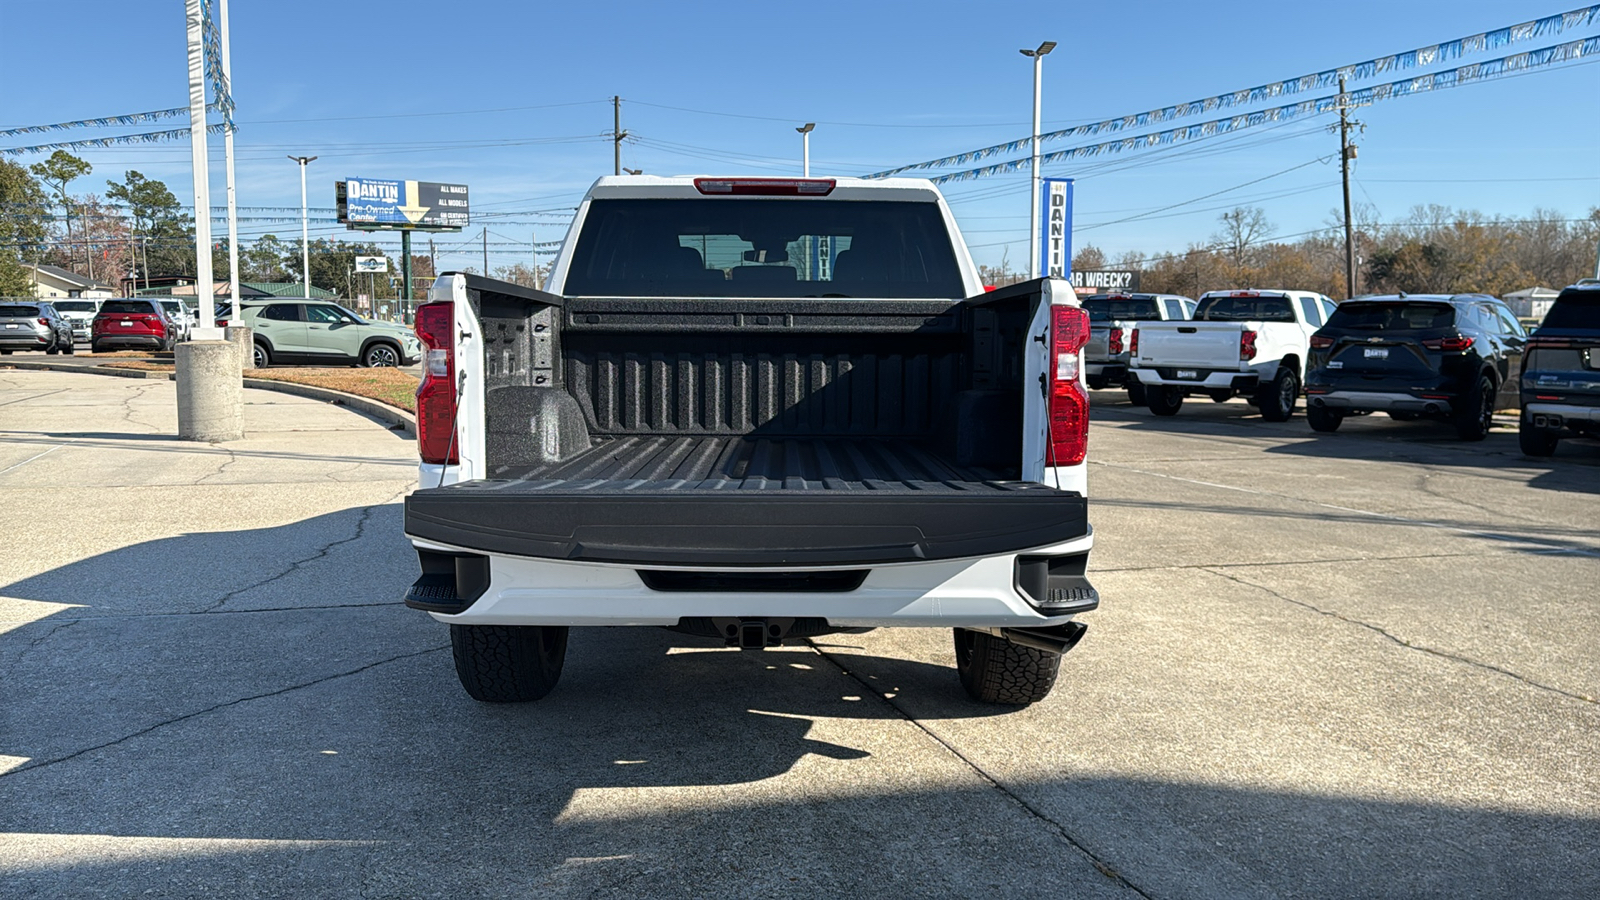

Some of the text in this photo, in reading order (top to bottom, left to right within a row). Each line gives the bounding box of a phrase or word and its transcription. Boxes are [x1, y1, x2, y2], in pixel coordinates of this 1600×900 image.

[348, 180, 398, 199] DANTIN
[440, 185, 467, 194] ALL MAKES
[438, 198, 468, 207] ALL MODELS
[349, 203, 395, 214] Pre-Owned
[349, 212, 377, 222] Center
[1050, 194, 1064, 277] DANTIN
[819, 236, 829, 281] ANTI
[1070, 272, 1132, 288] AR WRECK?
[1363, 348, 1389, 358] DANTIN
